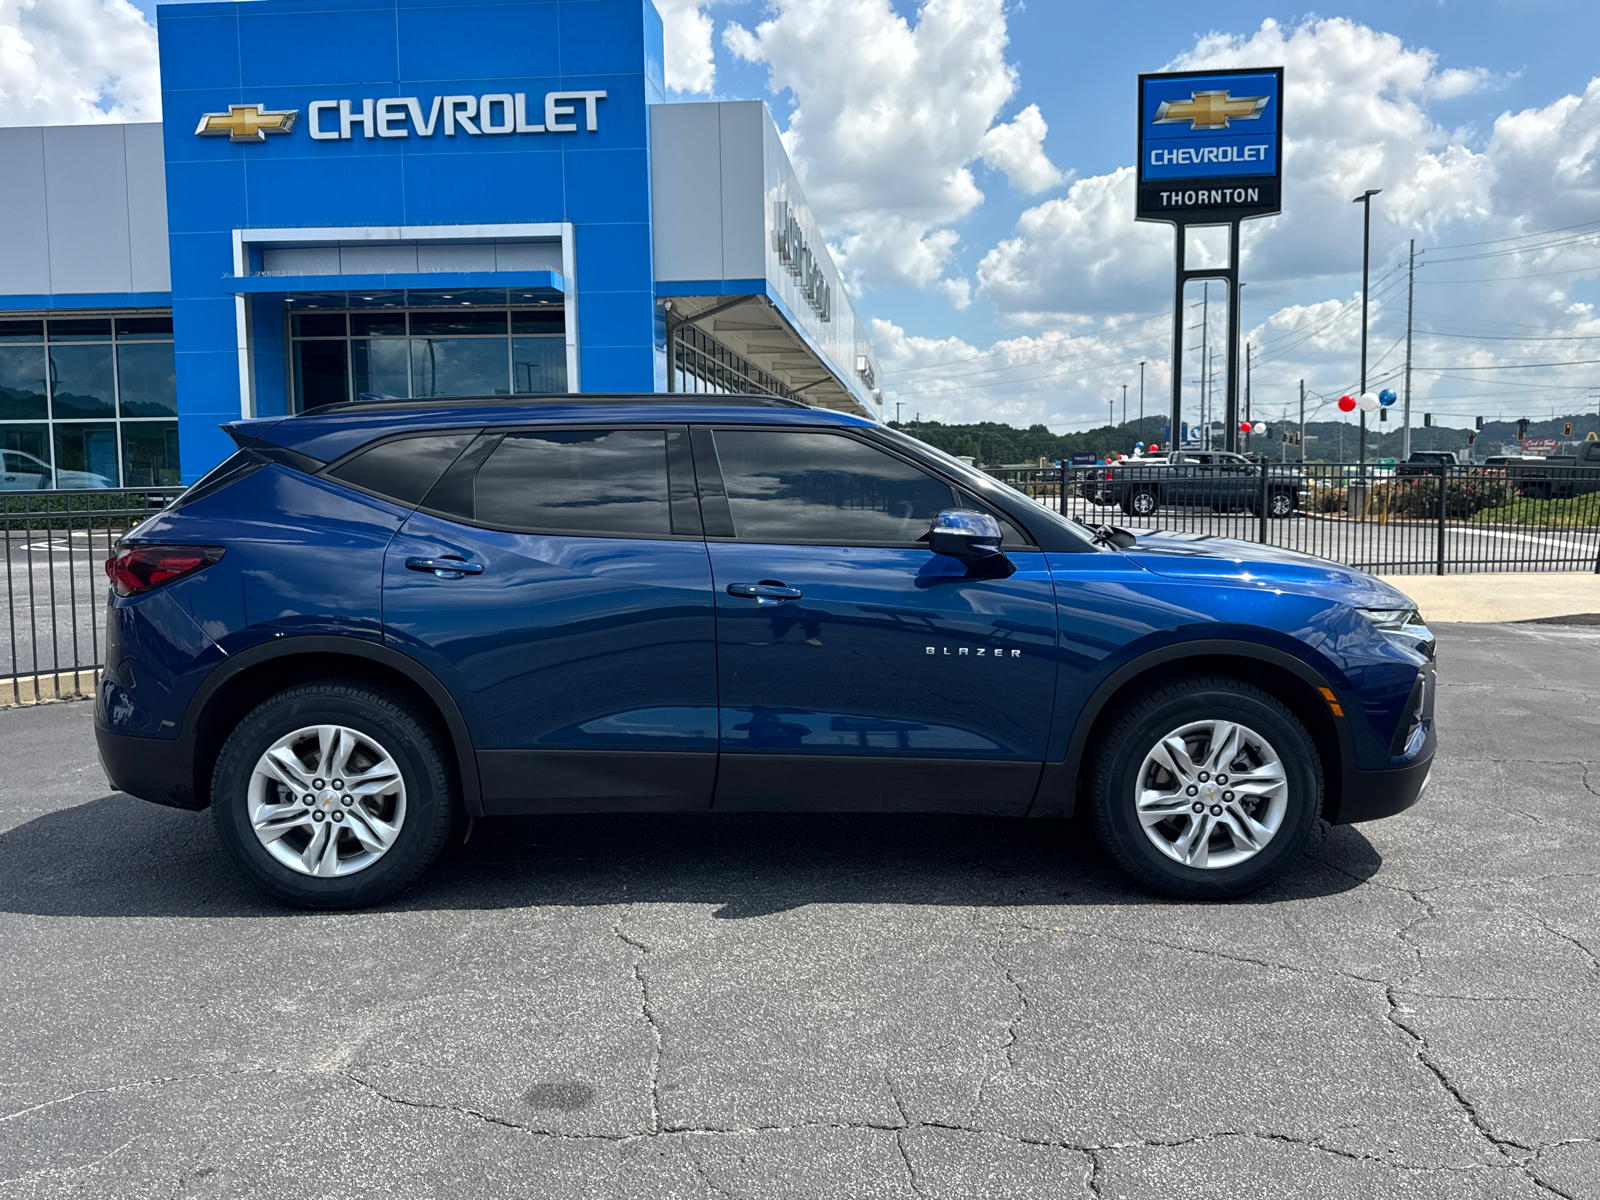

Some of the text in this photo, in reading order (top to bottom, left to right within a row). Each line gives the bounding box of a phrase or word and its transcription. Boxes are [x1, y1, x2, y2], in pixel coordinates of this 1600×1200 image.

[309, 90, 607, 140] CHEVROLET
[1151, 144, 1268, 166] CHEVROLET
[1160, 187, 1259, 207] THORNTON
[926, 646, 1021, 658] BLAZER
[227, 719, 270, 774] KELLY
[359, 709, 410, 748] 235/65R18
[381, 830, 423, 885] KELLY
